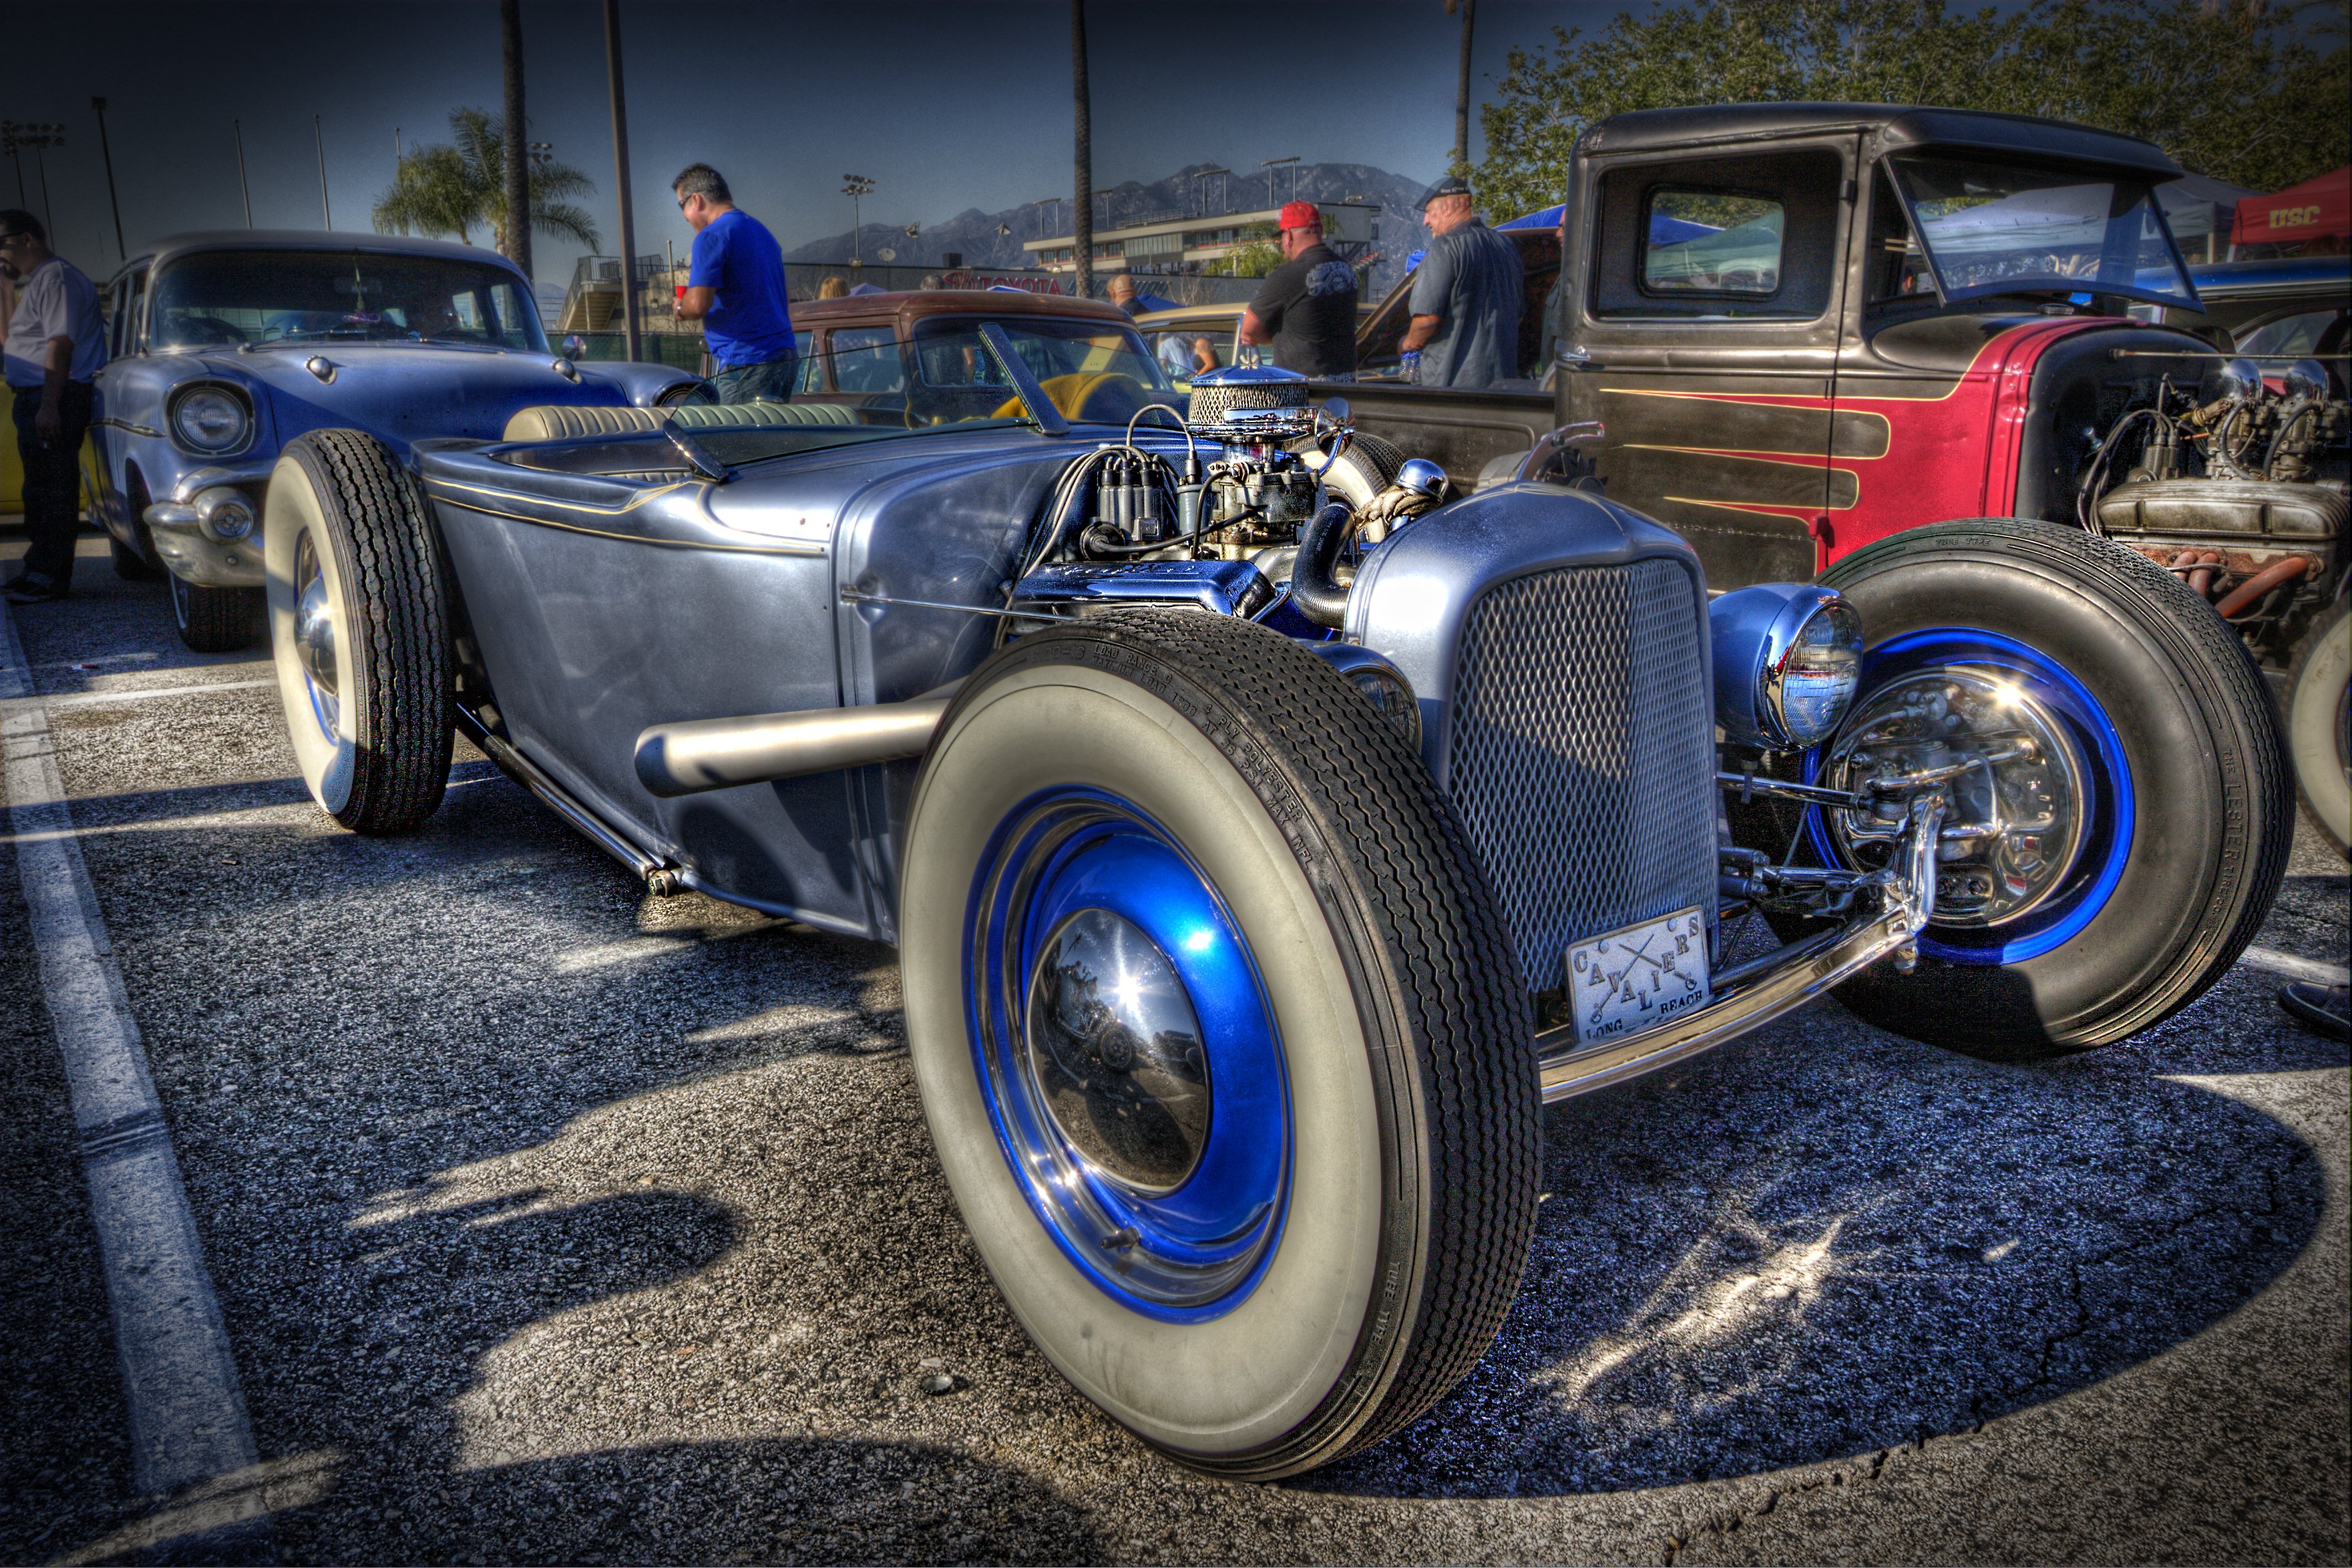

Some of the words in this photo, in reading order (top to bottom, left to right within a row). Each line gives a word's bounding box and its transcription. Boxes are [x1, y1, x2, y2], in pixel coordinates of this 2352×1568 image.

[2269, 206, 2321, 228] USC
[1091, 655, 1135, 678] MAXIMUM
[1139, 673, 1167, 695] LOAD
[1201, 720, 1218, 735] AT
[1095, 643, 1119, 658] LOAD
[1126, 653, 1159, 676] RANGE
[1218, 716, 1240, 739] PLY
[1243, 742, 1303, 823] POLYESTER
[2224, 784, 2243, 859] LESTER
[1573, 914, 1700, 1012] CAVALIERS
[1585, 1018, 1623, 1040] LONG
